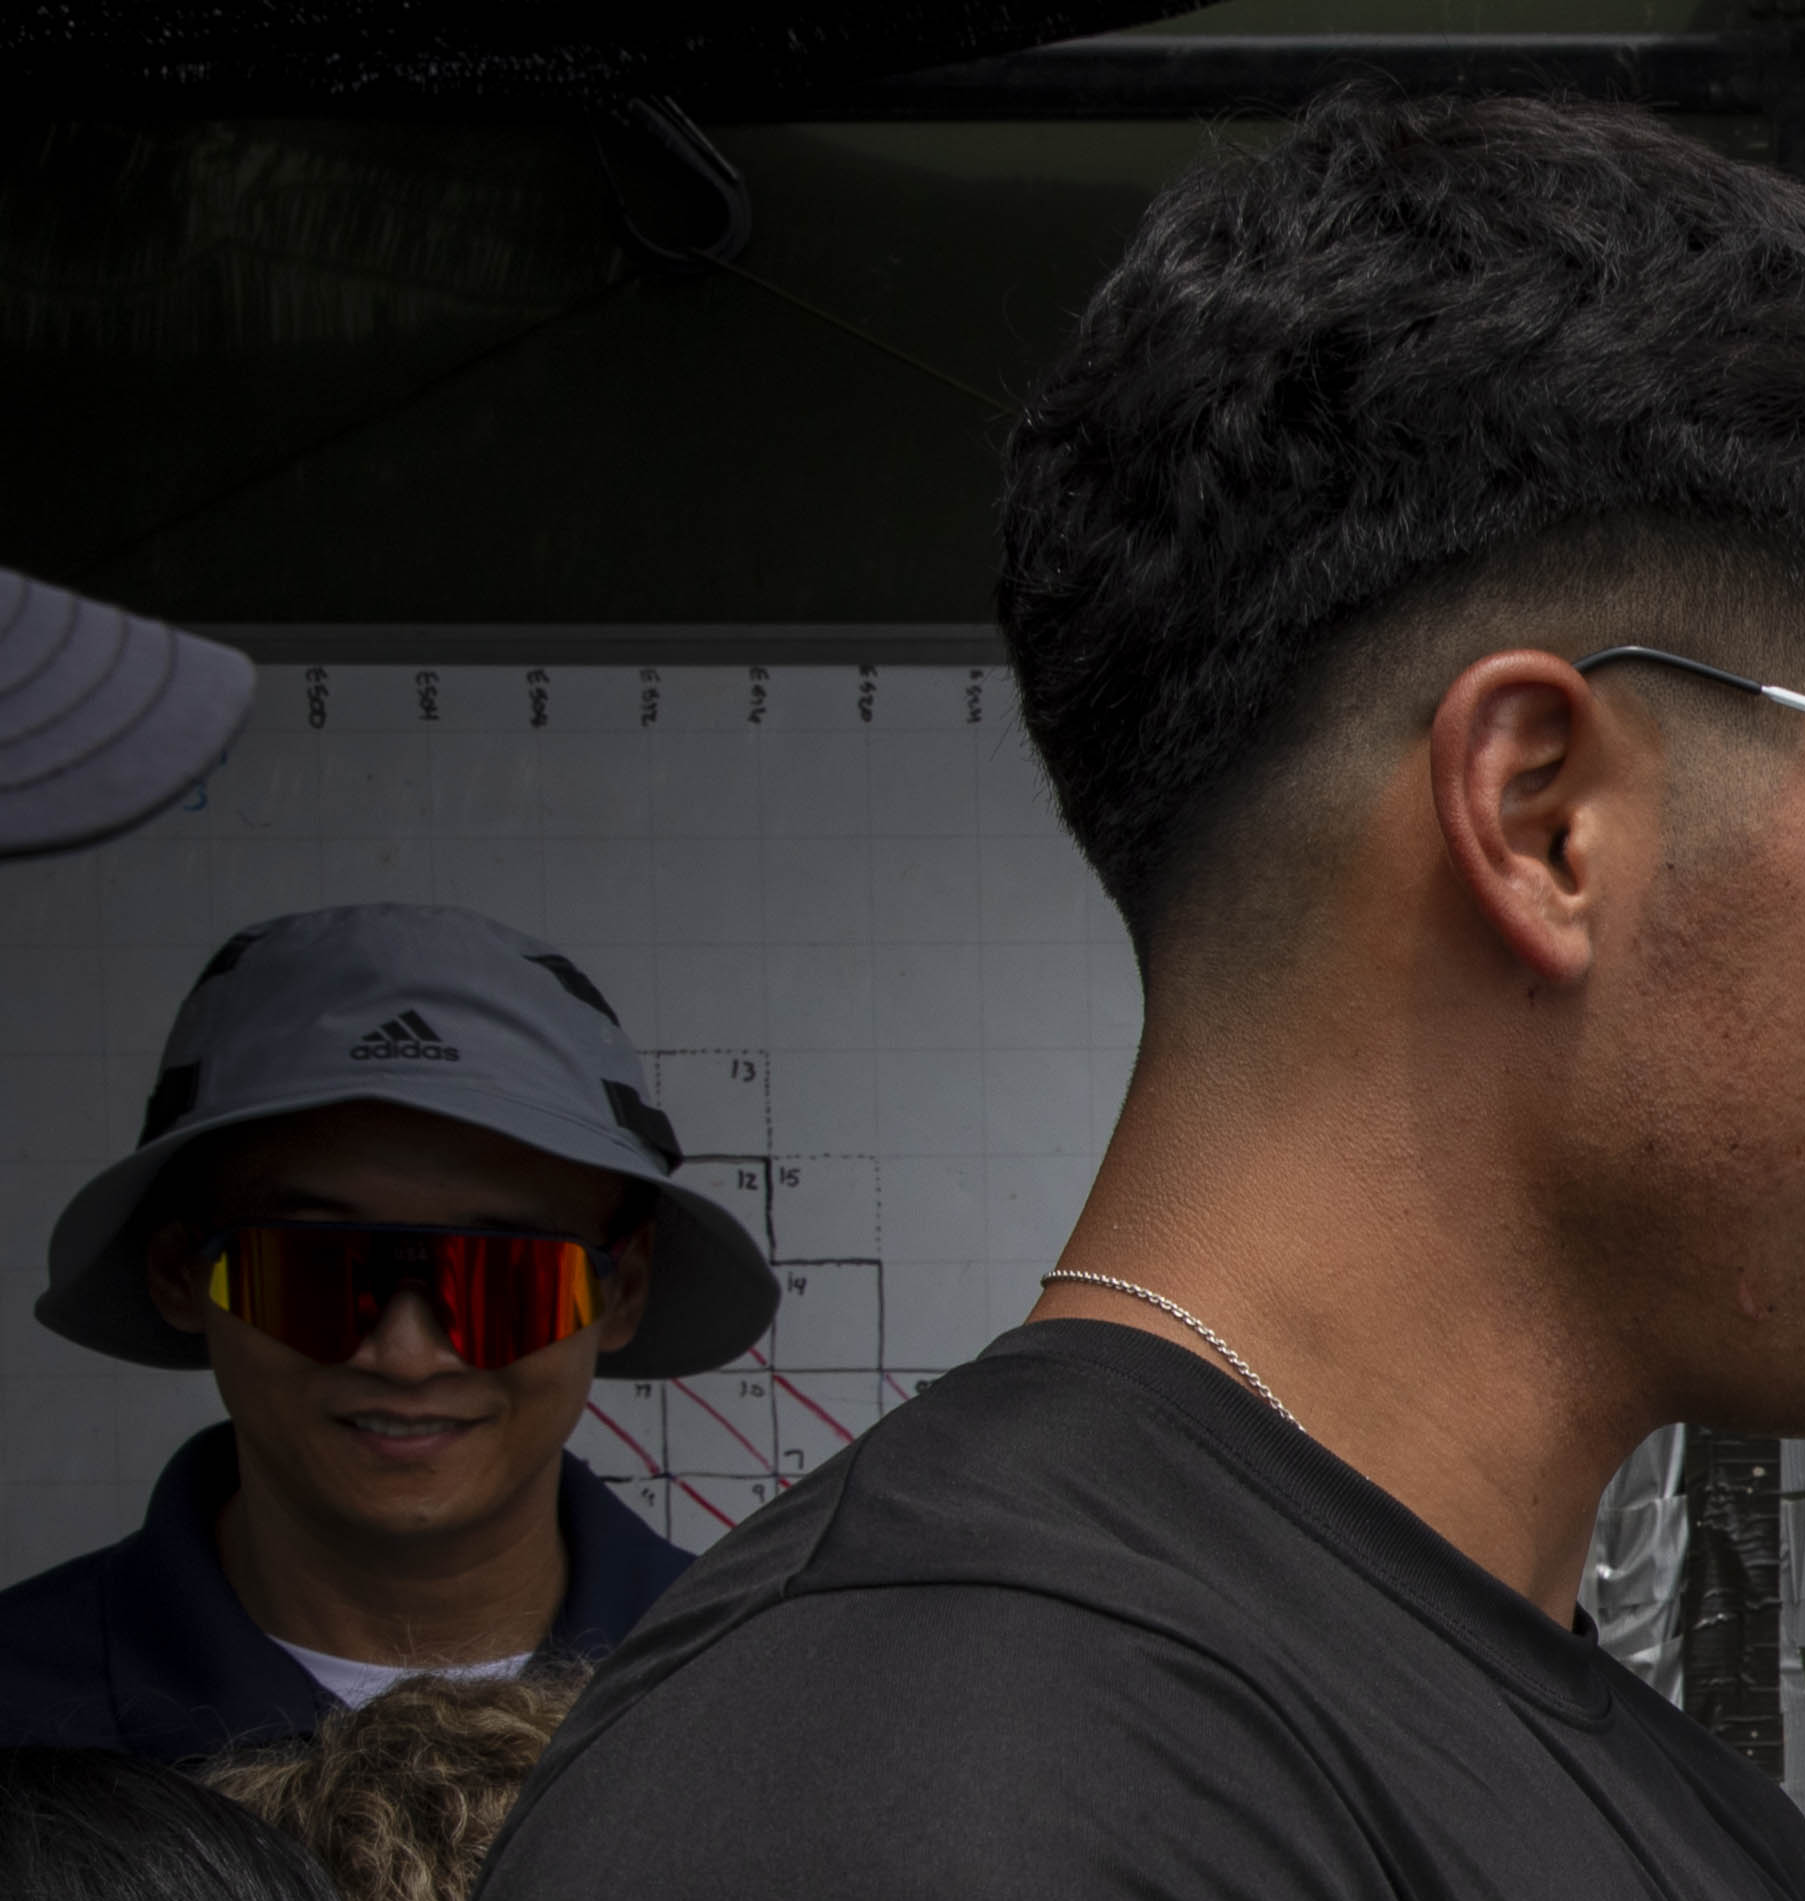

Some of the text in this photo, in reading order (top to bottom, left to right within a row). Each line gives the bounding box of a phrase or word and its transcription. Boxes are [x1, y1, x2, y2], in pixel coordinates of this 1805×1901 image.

[349, 1040, 460, 1062] adidas
[730, 1058, 756, 1083] 13
[737, 1169, 759, 1190] 12
[779, 1167, 801, 1188] 15
[752, 1483, 766, 1503] 9
